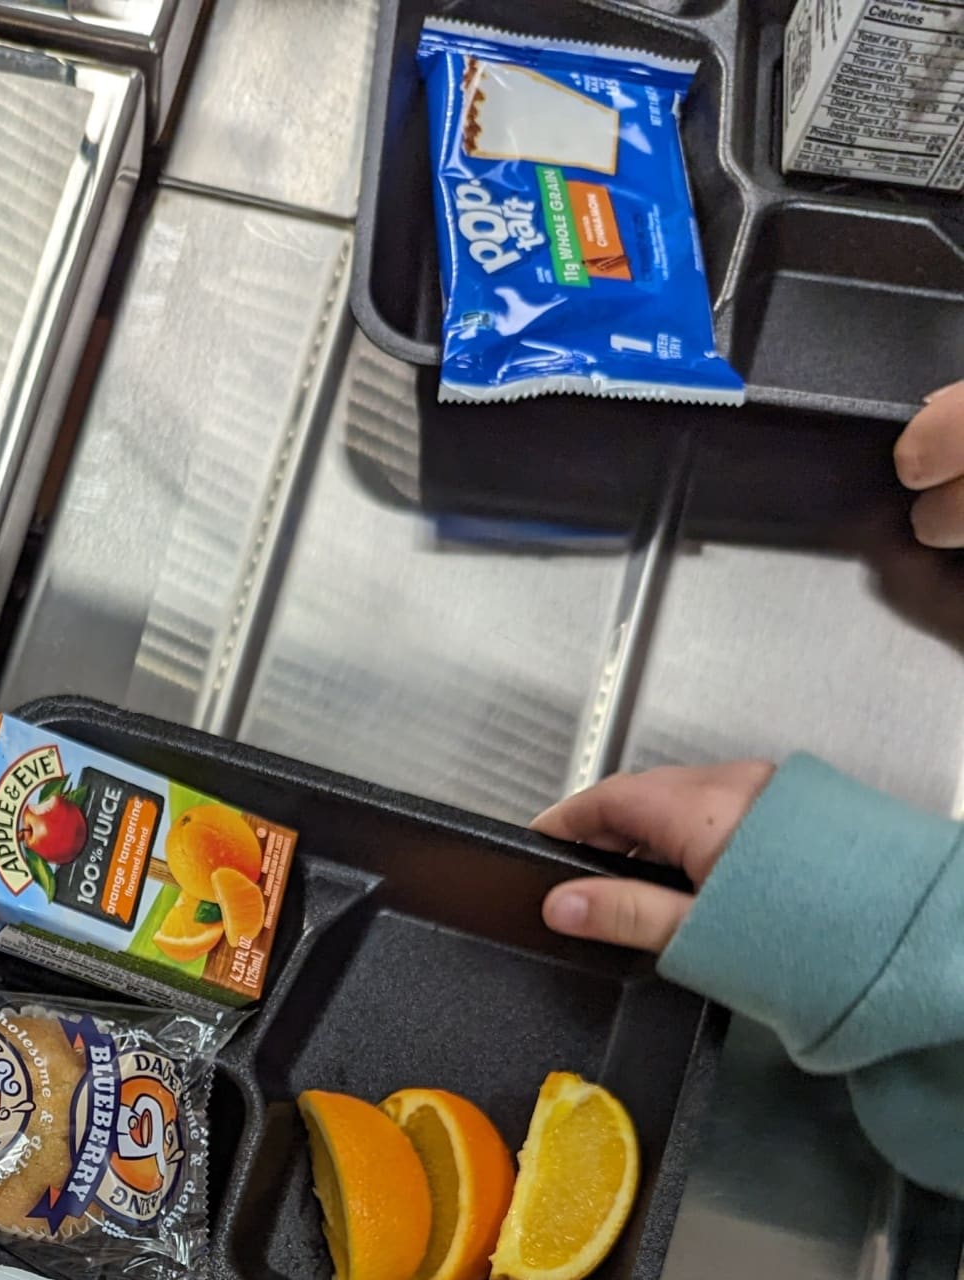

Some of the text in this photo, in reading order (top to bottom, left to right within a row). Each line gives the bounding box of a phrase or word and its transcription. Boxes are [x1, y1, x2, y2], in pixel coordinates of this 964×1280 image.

[868, 5, 924, 25] Calories
[858, 30, 881, 42] Total
[884, 35, 899, 46] Fat
[836, 75, 872, 90] Sodium
[840, 65, 896, 82] Cholesterol
[543, 170, 564, 212] GRAIN
[552, 214, 573, 260] WHOLE
[587, 193, 608, 247] CINNAMON
[610, 333, 652, 354] 1
[4, 784, 20, 797] &
[77, 786, 122, 905] 100% JUICE
[107, 800, 143, 915] orange tangerine
[124, 828, 149, 897] flavored blend
[229, 935, 252, 983] 4.23 FL OZ
[67, 1045, 116, 1203] BLUEBERRY
